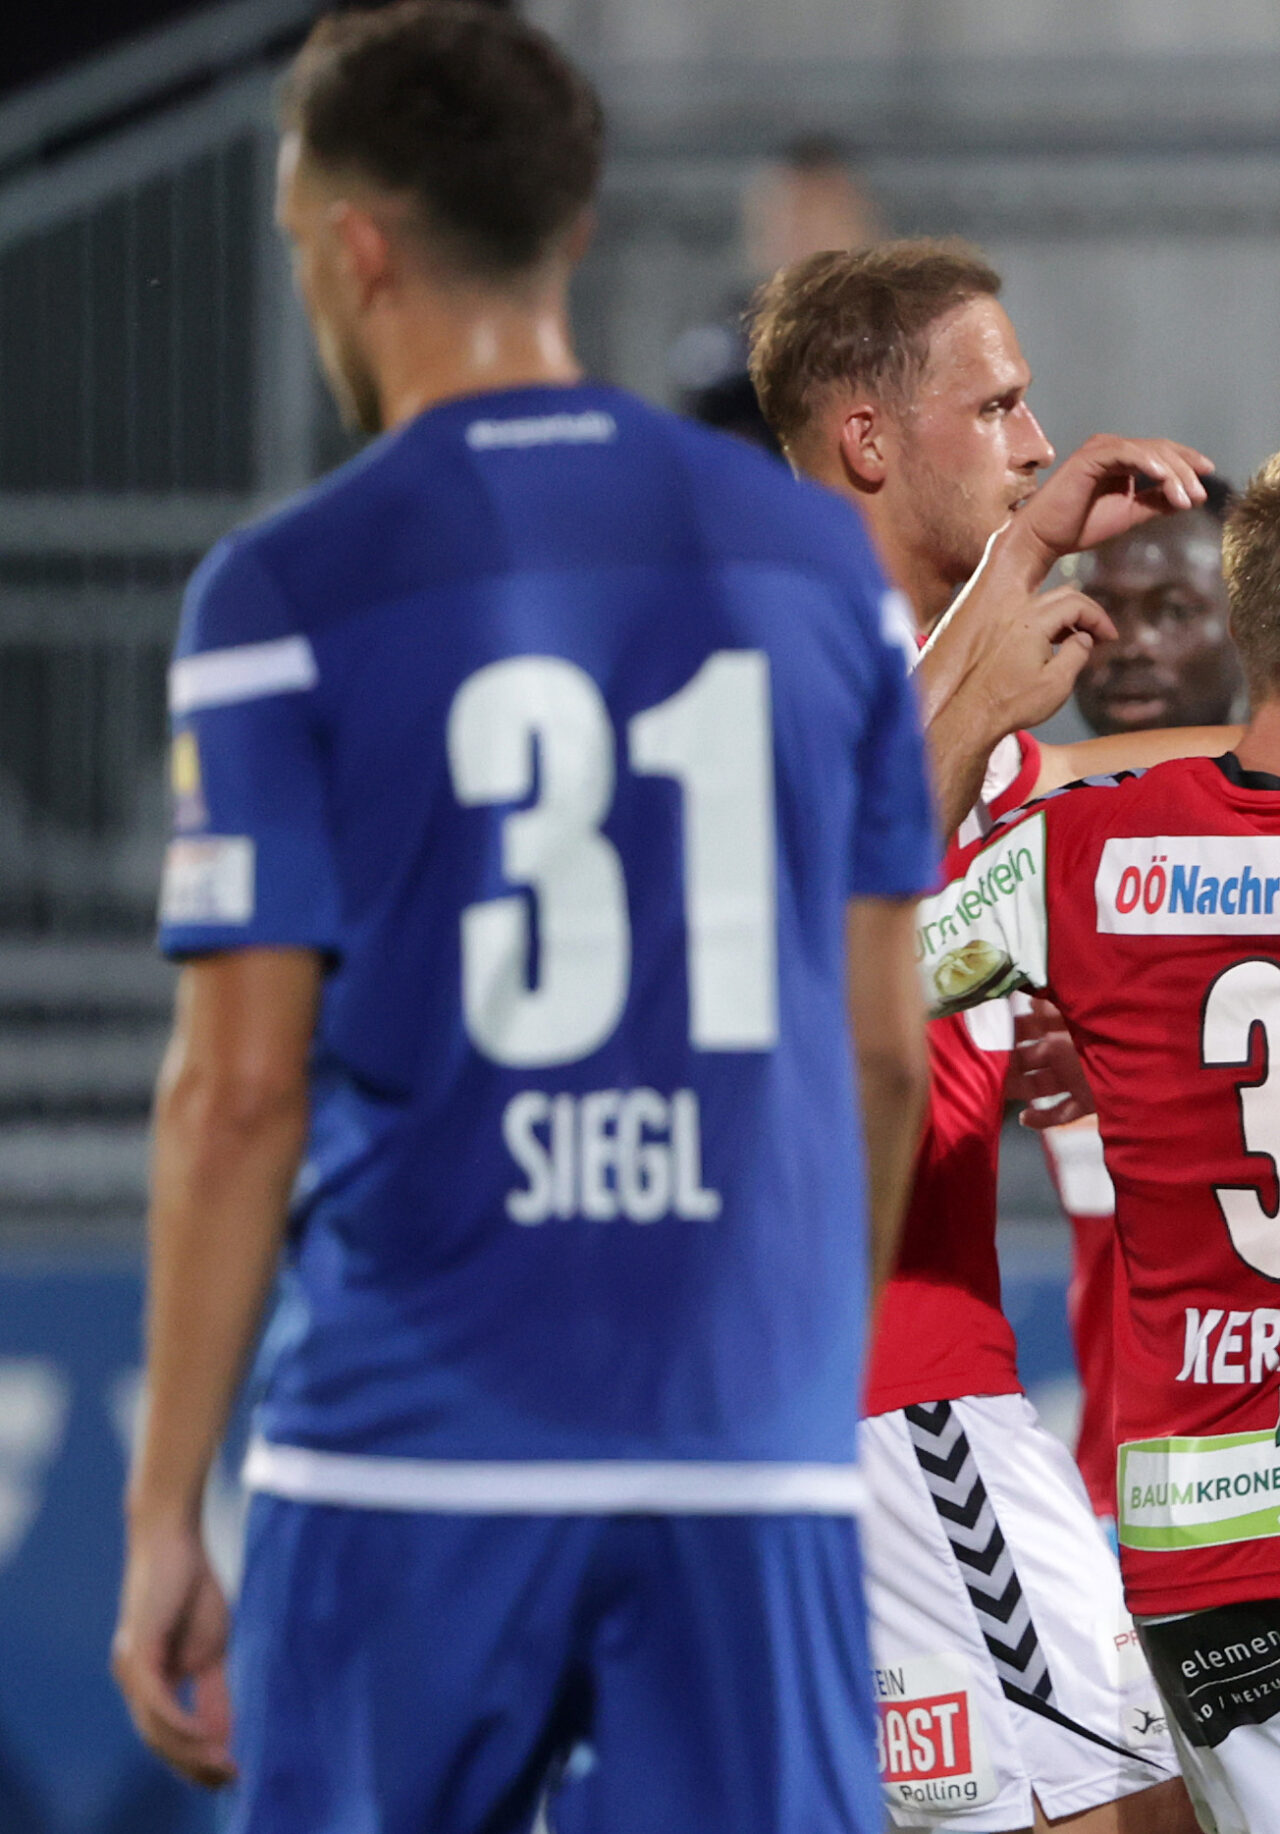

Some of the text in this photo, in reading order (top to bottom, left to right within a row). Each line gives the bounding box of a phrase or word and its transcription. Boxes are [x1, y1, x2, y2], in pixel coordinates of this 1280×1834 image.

[447, 649, 779, 1069] 31
[503, 1088, 721, 1226] SIEGL
[899, 1780, 978, 1803] Polling
